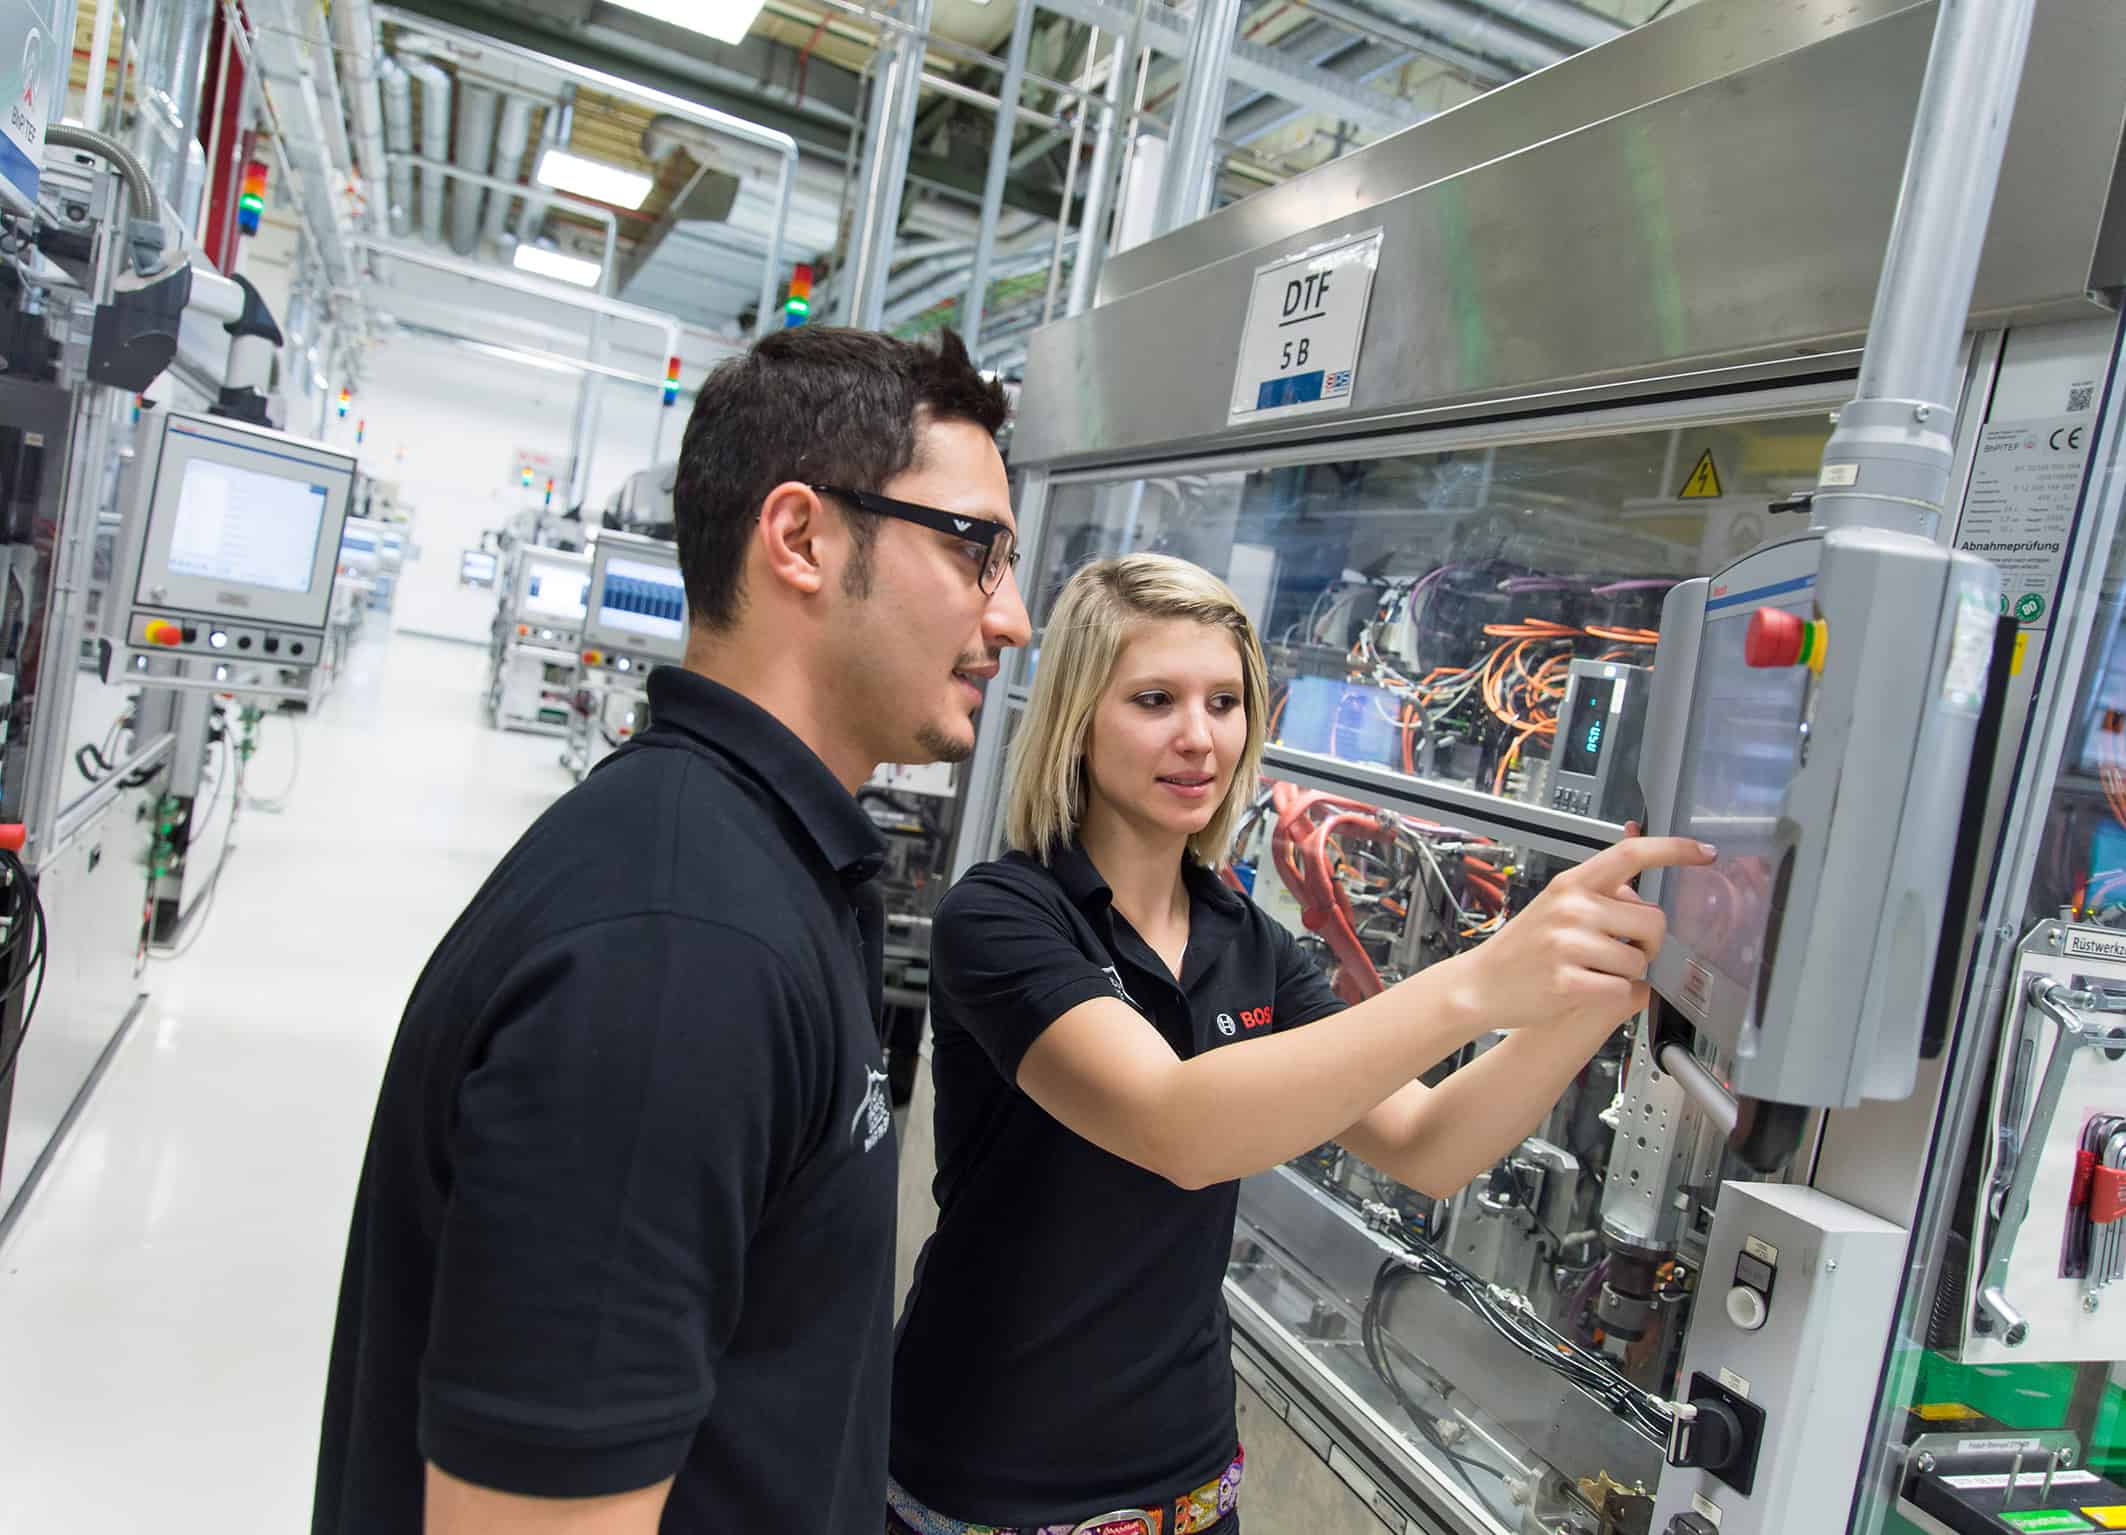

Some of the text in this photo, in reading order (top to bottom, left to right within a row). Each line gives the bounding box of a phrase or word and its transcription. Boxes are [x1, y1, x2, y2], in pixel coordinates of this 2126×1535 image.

[1283, 270, 1332, 317] DTF
[1281, 338, 1309, 370] 5 B
[2049, 427, 2083, 450] CE
[1960, 540, 2060, 553] Abnahmeprüfung
[2072, 936, 2126, 956] Rüstwerkz
